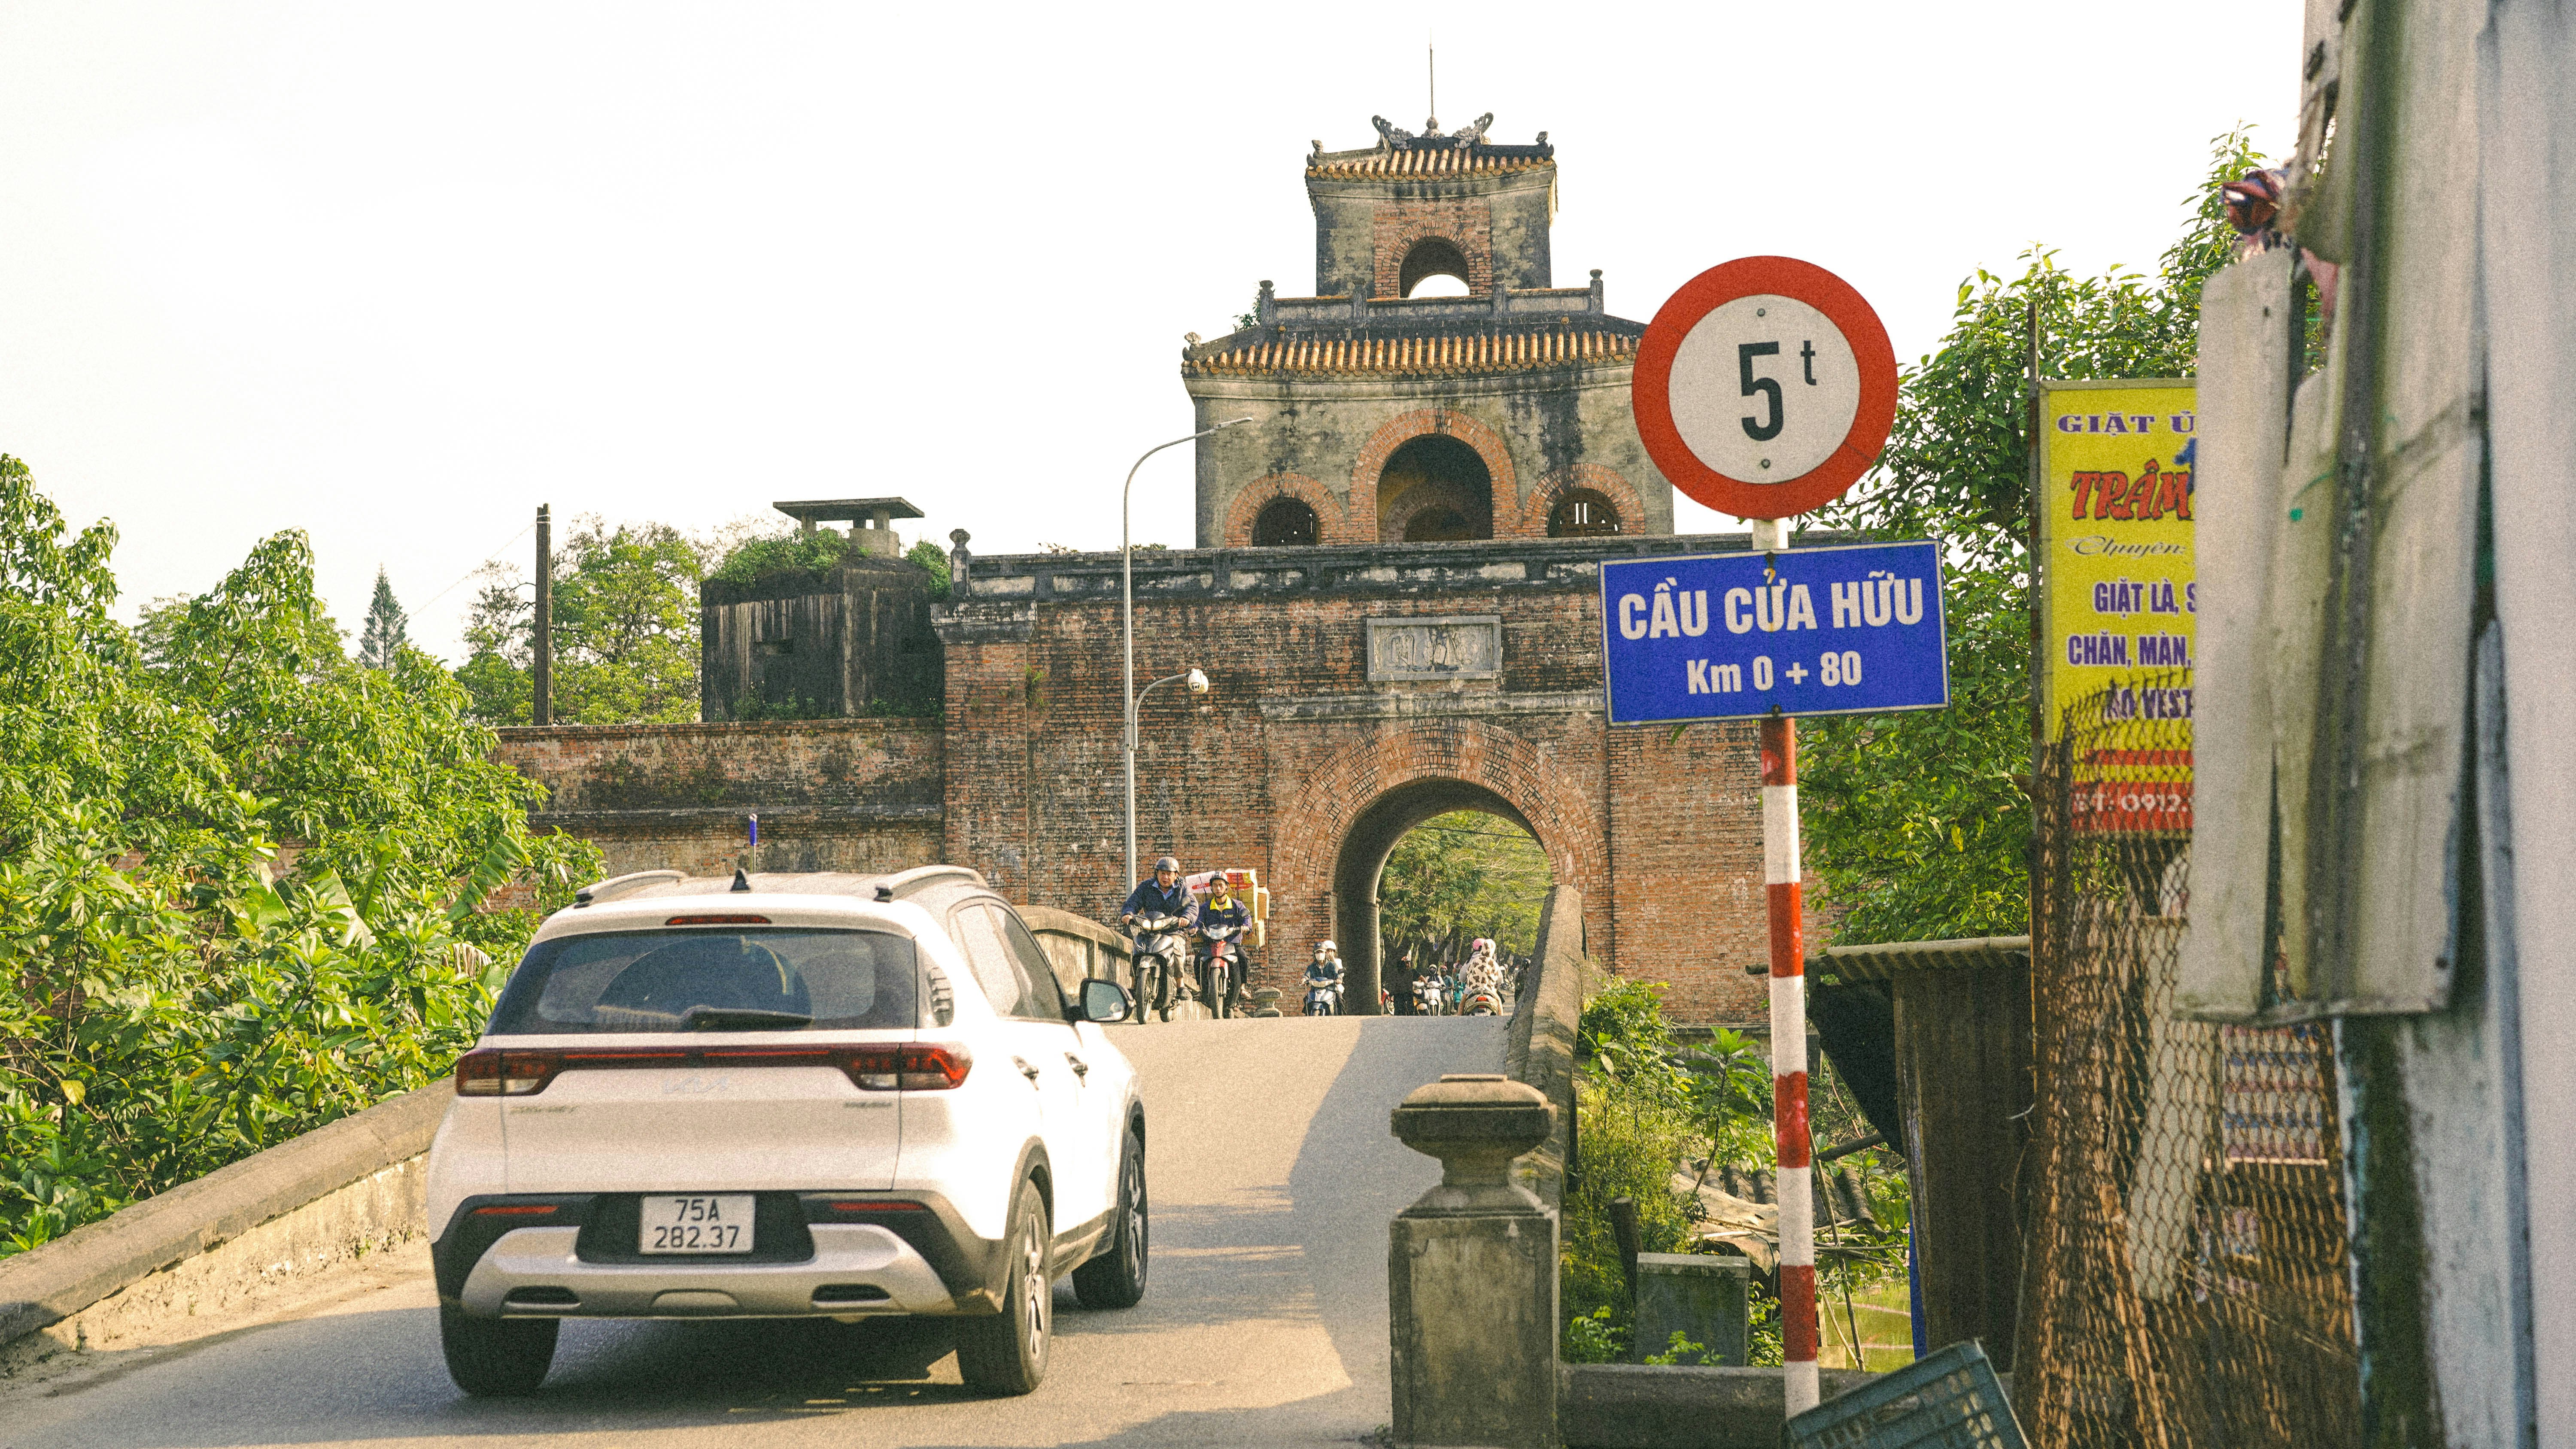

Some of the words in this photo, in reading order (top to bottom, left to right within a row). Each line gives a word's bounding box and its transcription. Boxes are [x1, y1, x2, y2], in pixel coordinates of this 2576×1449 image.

[1738, 341, 1783, 441] 5
[1800, 340, 1817, 385] t
[2058, 412, 2155, 436] GIẶT
[2070, 458, 2191, 521] TRÂM
[1619, 577, 1708, 640] CẦU
[1724, 568, 1818, 634] CỬA
[1831, 570, 1923, 628] HỮU
[2095, 578, 2143, 617] GIẶT
[2151, 578, 2179, 615] LÀ,
[2069, 631, 2131, 668] CHĂN,
[2139, 631, 2191, 667] MÀN,
[1686, 659, 1742, 694] Km
[1753, 655, 1774, 691] 0
[1785, 662, 1808, 685] +
[1820, 651, 1862, 687] 80
[675, 1199, 719, 1221] 75A
[654, 1225, 739, 1248] 282.37
